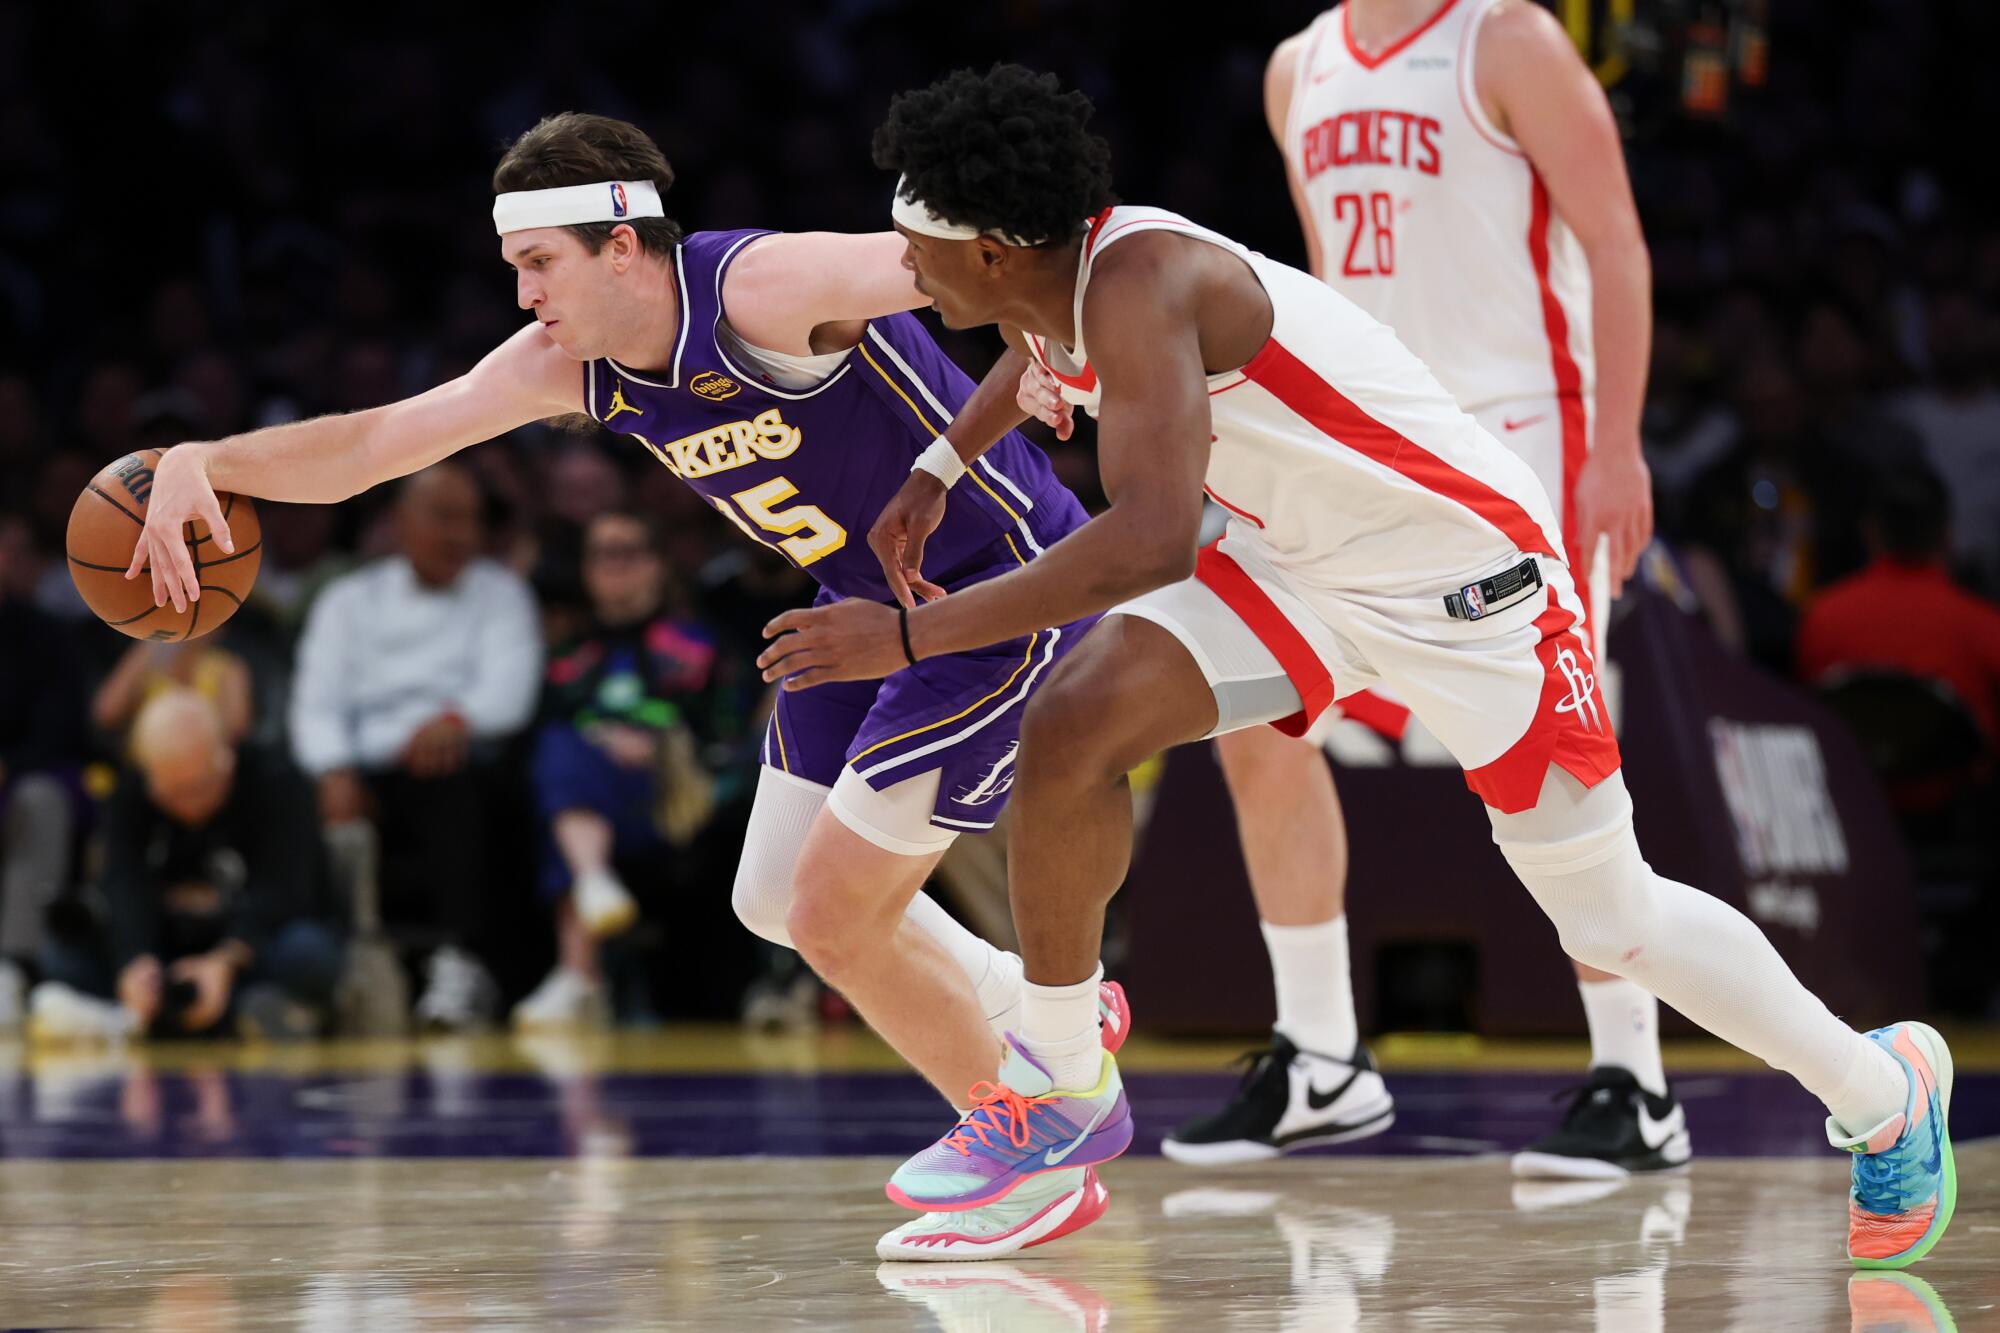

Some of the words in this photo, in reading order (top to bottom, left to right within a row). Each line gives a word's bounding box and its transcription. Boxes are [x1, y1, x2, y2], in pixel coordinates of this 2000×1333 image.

[1334, 192, 1393, 278] 28
[650, 407, 802, 479] KERS
[708, 476, 847, 567] 5
